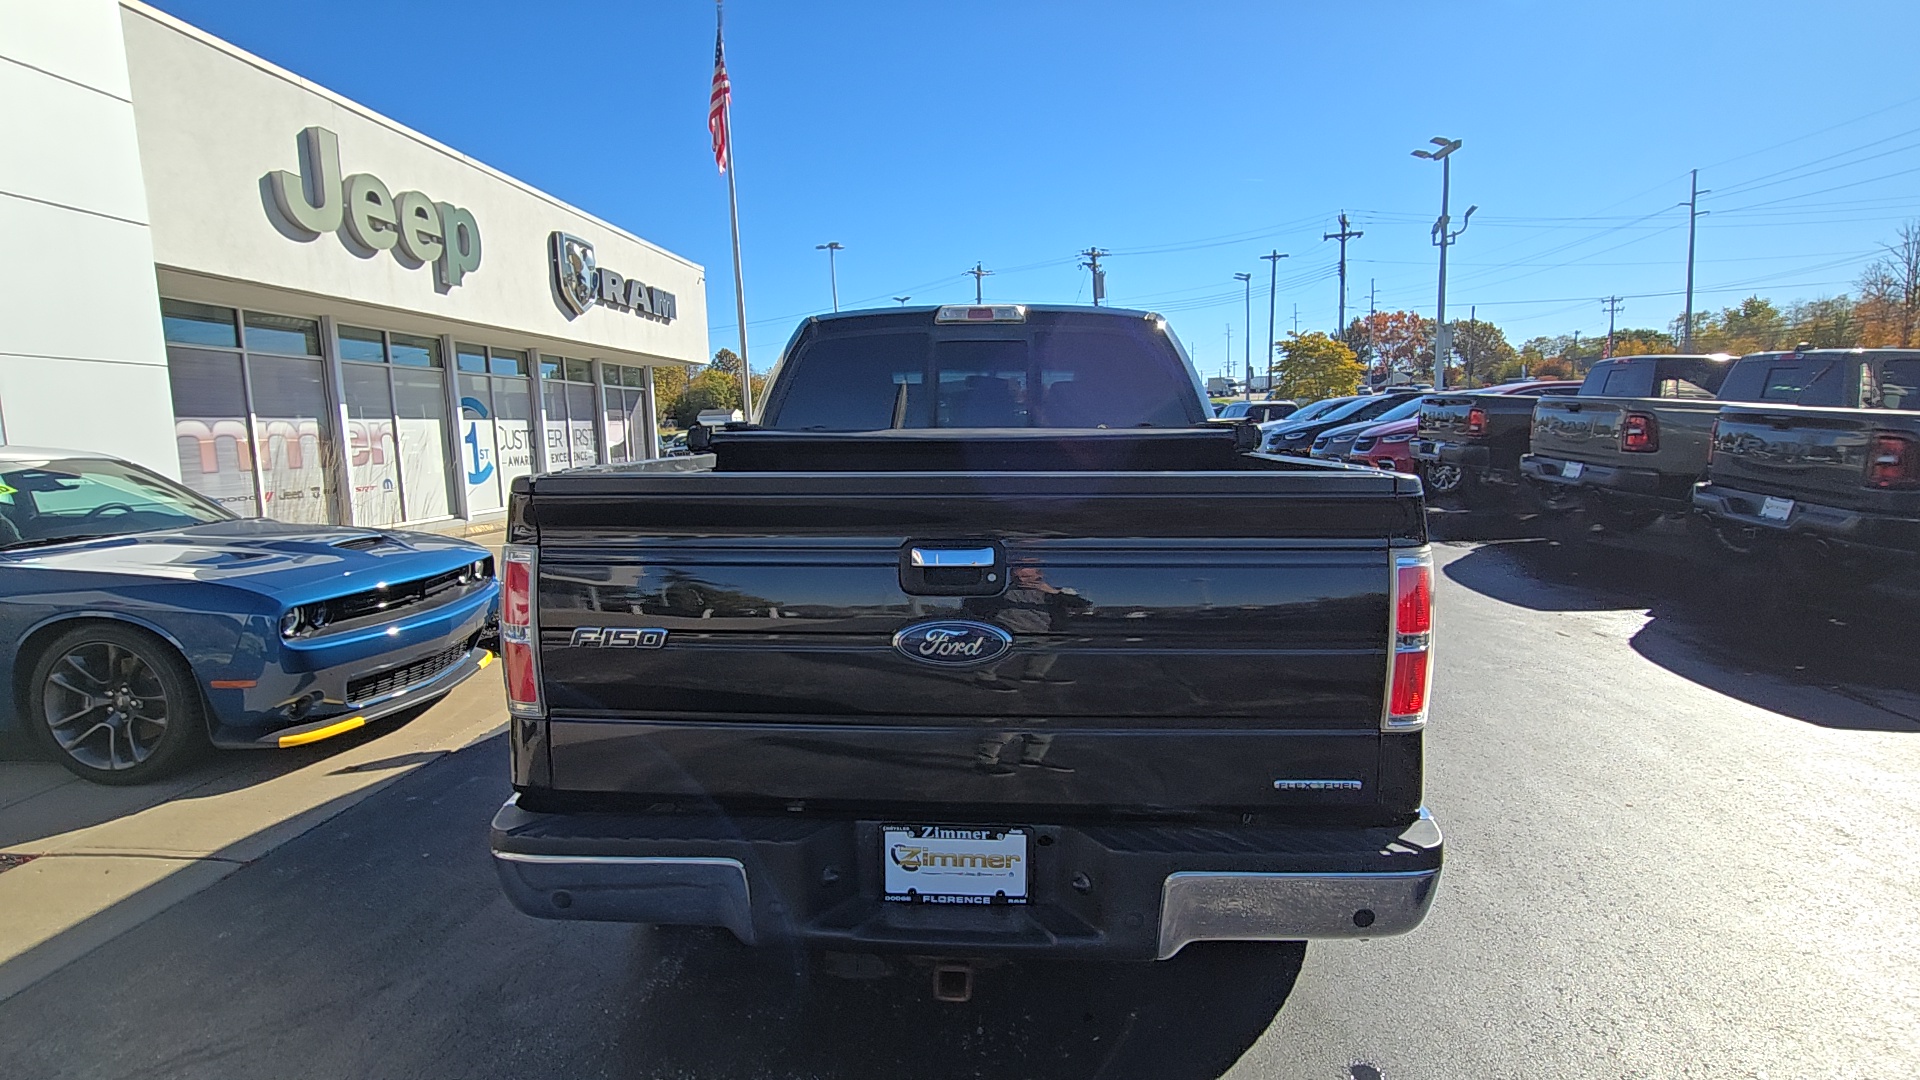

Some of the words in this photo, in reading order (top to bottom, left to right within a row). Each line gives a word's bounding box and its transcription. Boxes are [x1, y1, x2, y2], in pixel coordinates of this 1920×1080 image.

[258, 126, 482, 292] Jeep
[599, 267, 677, 322] RAM
[499, 425, 564, 451] USTOER
[508, 454, 534, 467] AWARD
[551, 451, 588, 464] EXCEENCE
[569, 627, 668, 648] F-150
[920, 628, 984, 655] Ford
[1279, 781, 1312, 790] FLEX
[921, 826, 991, 840] Zimmer
[899, 846, 1021, 868] Zimmer
[923, 895, 990, 904] FLORENCE
